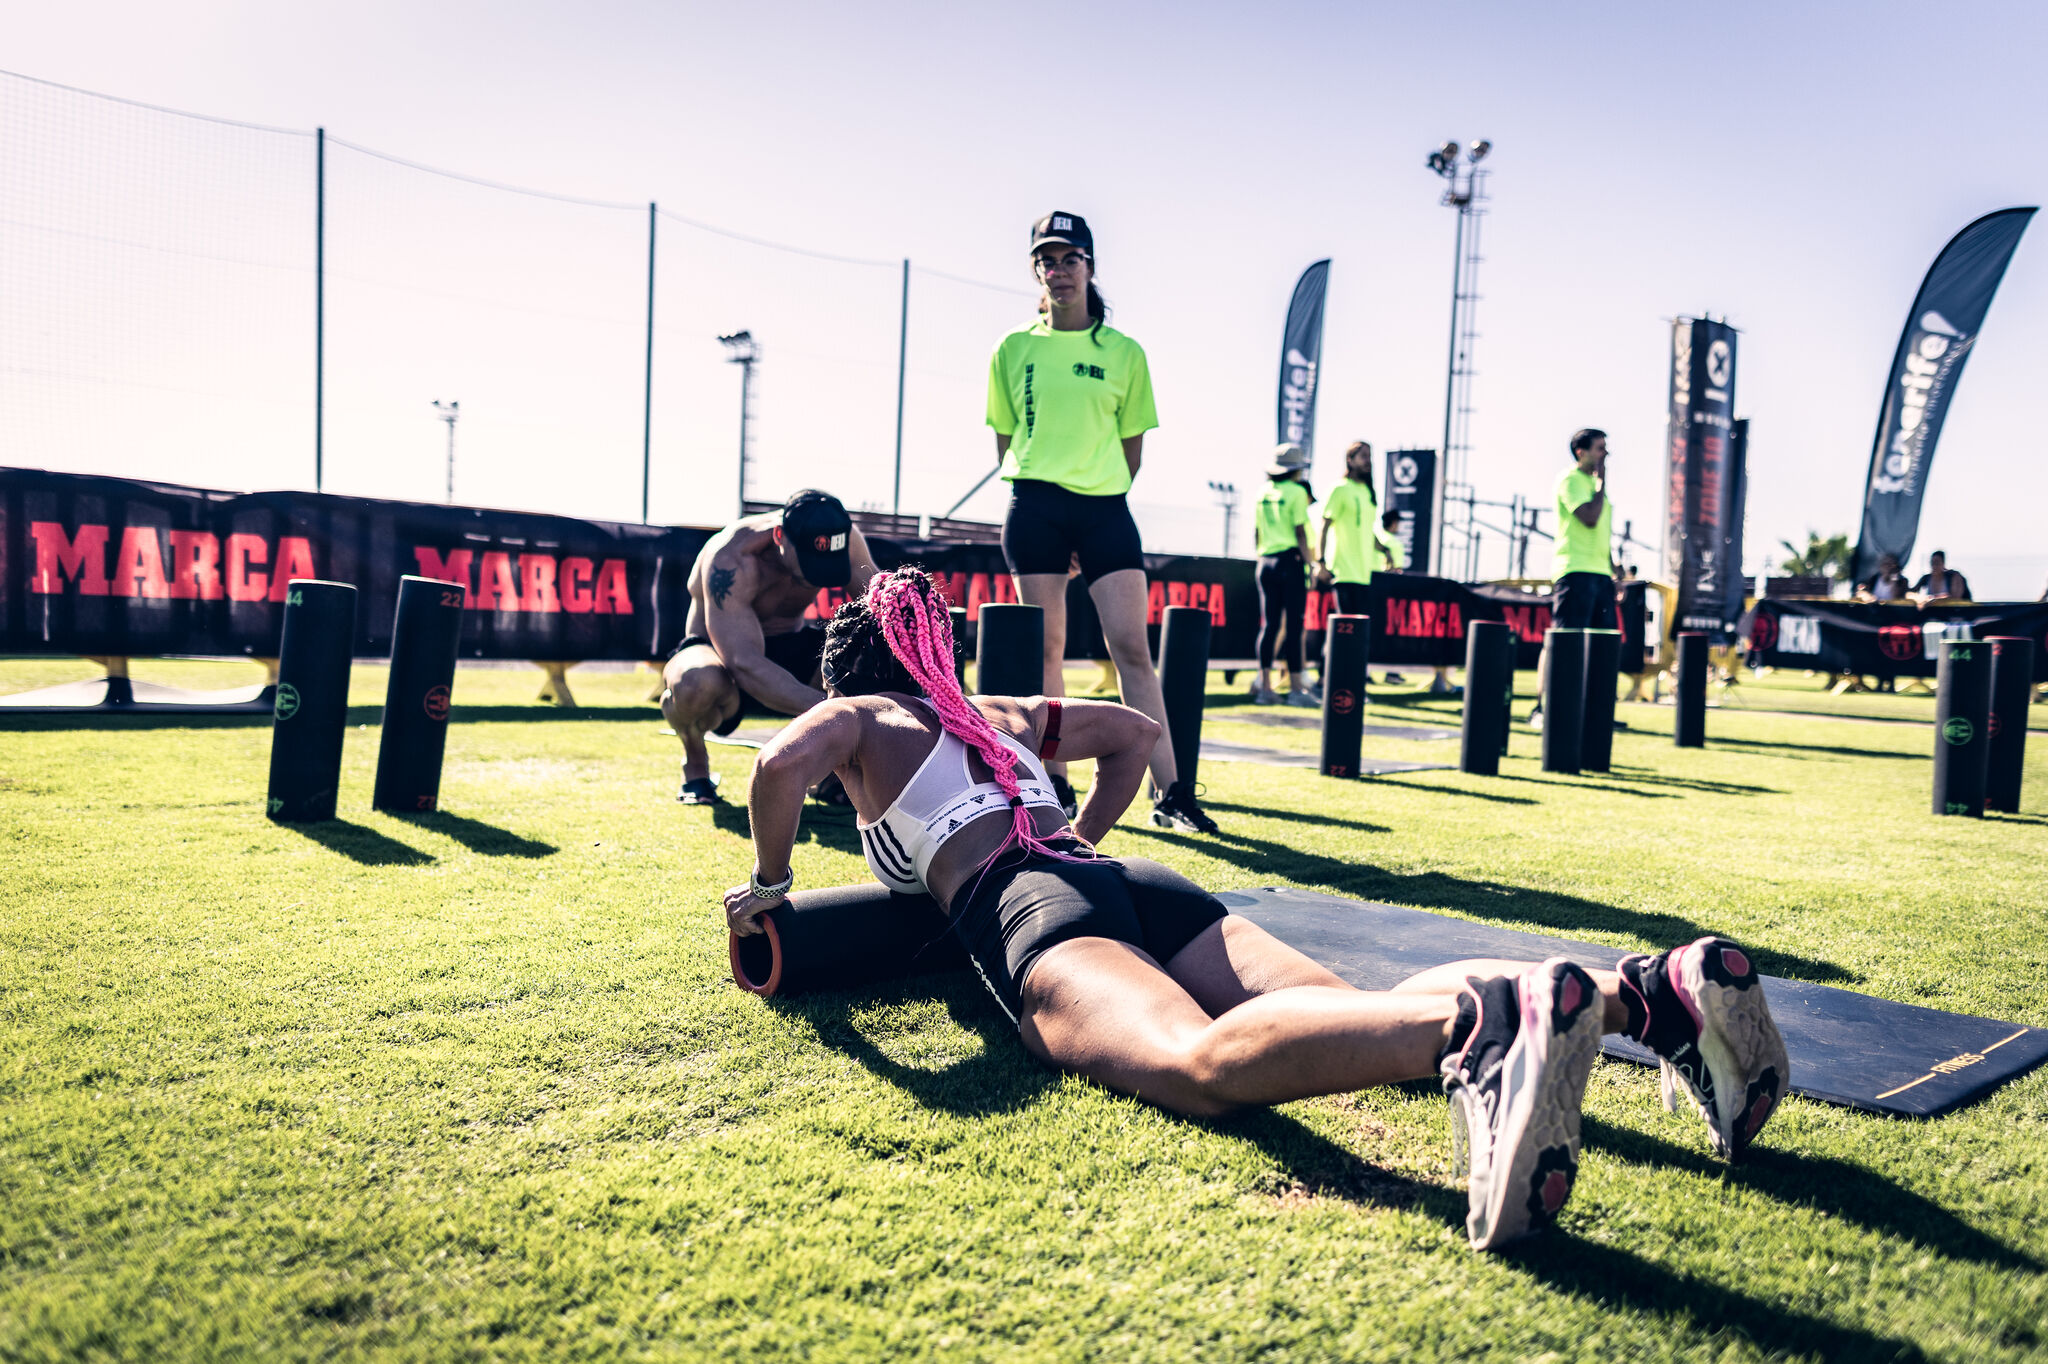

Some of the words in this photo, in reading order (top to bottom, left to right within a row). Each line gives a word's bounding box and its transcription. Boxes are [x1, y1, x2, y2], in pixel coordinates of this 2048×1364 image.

[1283, 348, 1316, 449] erife!
[31, 520, 316, 603] MARCA
[414, 546, 634, 615] MARCA
[440, 591, 461, 608] 22
[932, 571, 1017, 621] MAR
[1147, 581, 1226, 627] ARCA
[1386, 597, 1464, 638] MARCA
[1337, 623, 1354, 634] 22
[1949, 648, 1972, 662] 44
[1929, 1052, 1985, 1074] FITNESS
